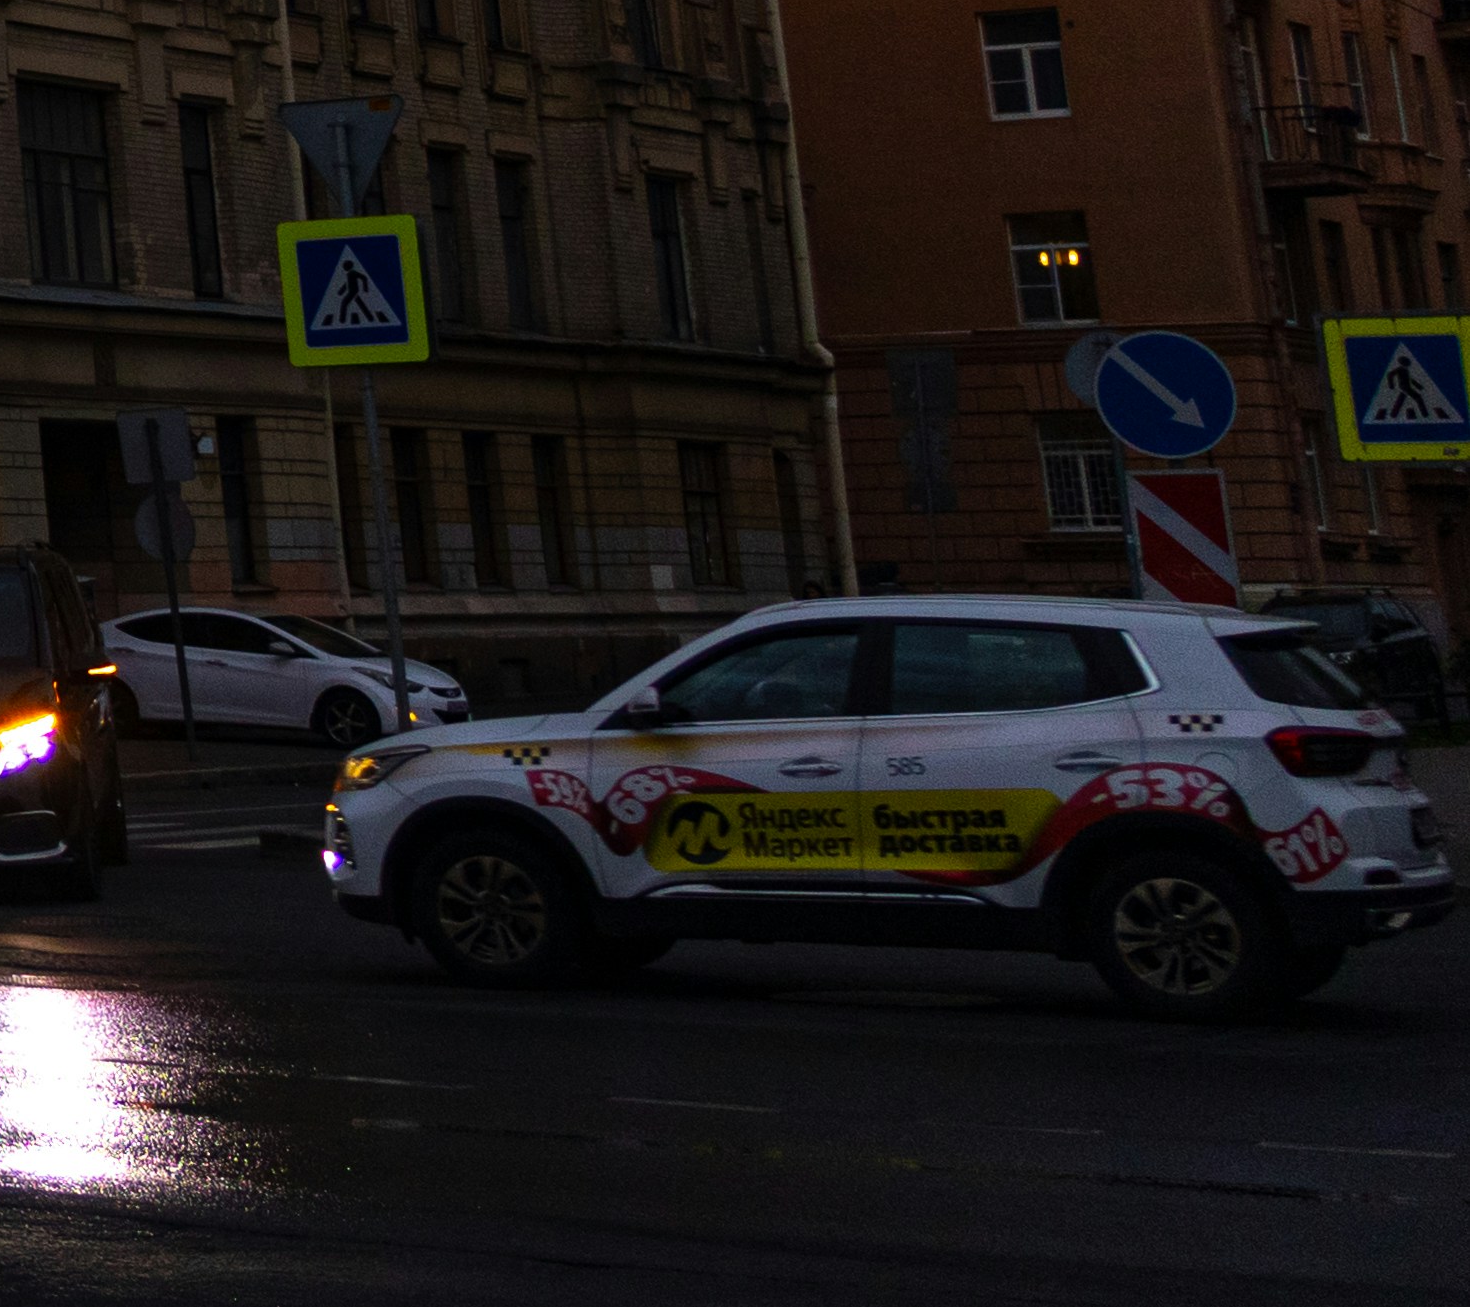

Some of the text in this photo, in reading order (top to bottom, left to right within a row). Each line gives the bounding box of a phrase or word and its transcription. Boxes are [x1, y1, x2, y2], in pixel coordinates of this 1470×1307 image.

[888, 756, 926, 776] 585
[1091, 768, 1231, 817] -53%
[739, 803, 846, 830] Яндекс
[874, 804, 1006, 833] быстрая
[744, 832, 855, 862] Маркет
[879, 832, 1020, 858] доставка
